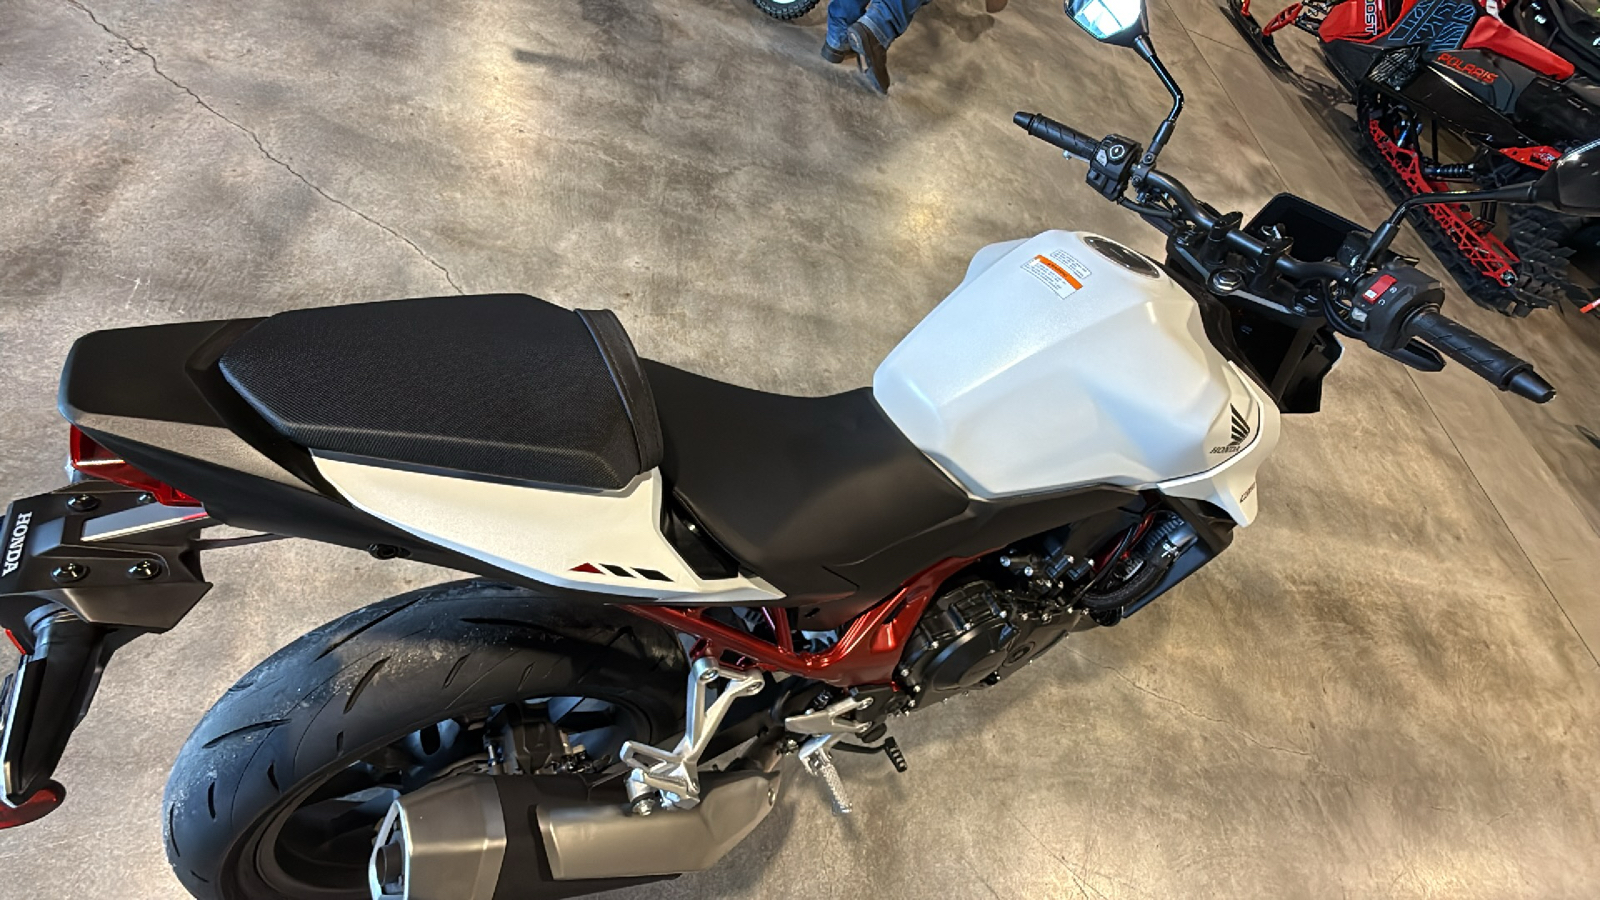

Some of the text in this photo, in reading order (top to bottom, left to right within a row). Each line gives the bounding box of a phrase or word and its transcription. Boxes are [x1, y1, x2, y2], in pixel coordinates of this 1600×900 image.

[1365, 0, 1377, 35] OST
[1437, 52, 1499, 84] POLARIS
[1209, 446, 1241, 454] HONDA
[1, 511, 33, 577] HONDA
